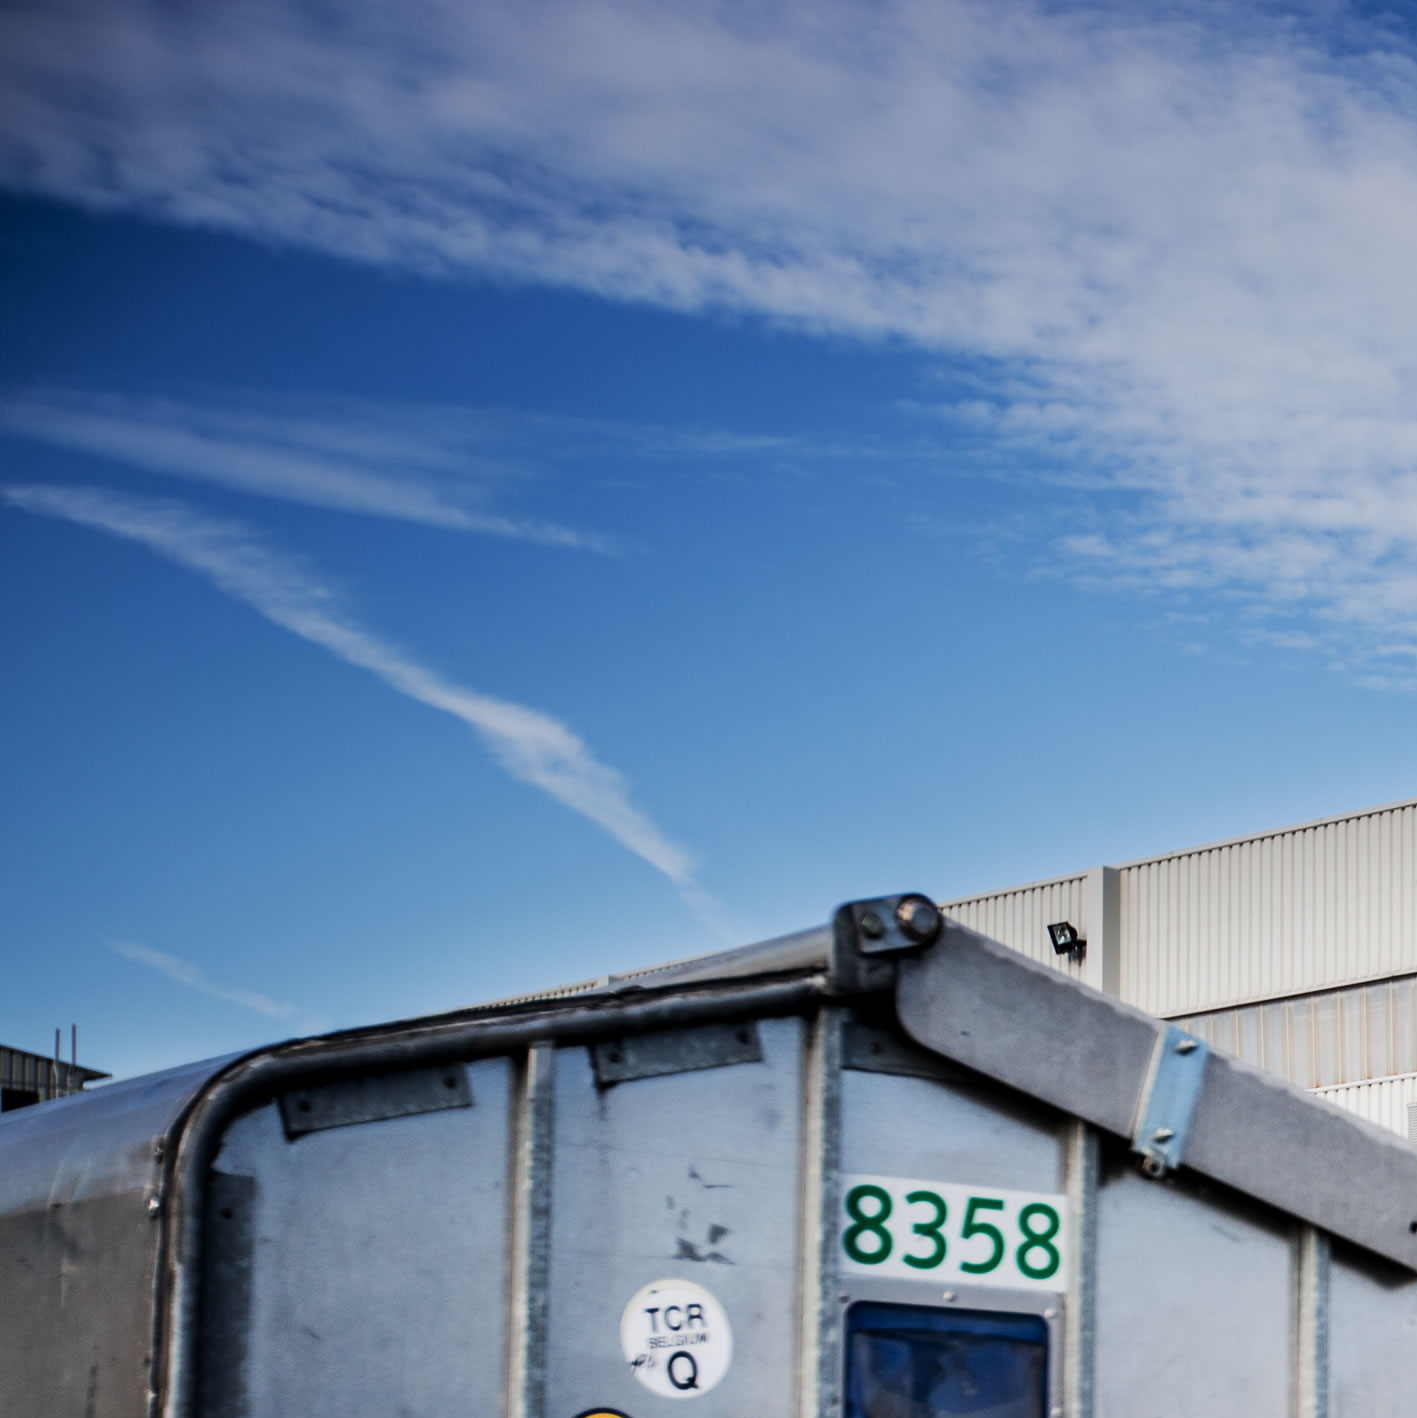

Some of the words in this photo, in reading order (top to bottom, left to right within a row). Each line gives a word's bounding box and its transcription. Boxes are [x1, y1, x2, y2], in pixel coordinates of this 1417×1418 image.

[842, 1184, 1061, 1280] 8358
[644, 1303, 708, 1333] TCR
[667, 1350, 700, 1391] Q
